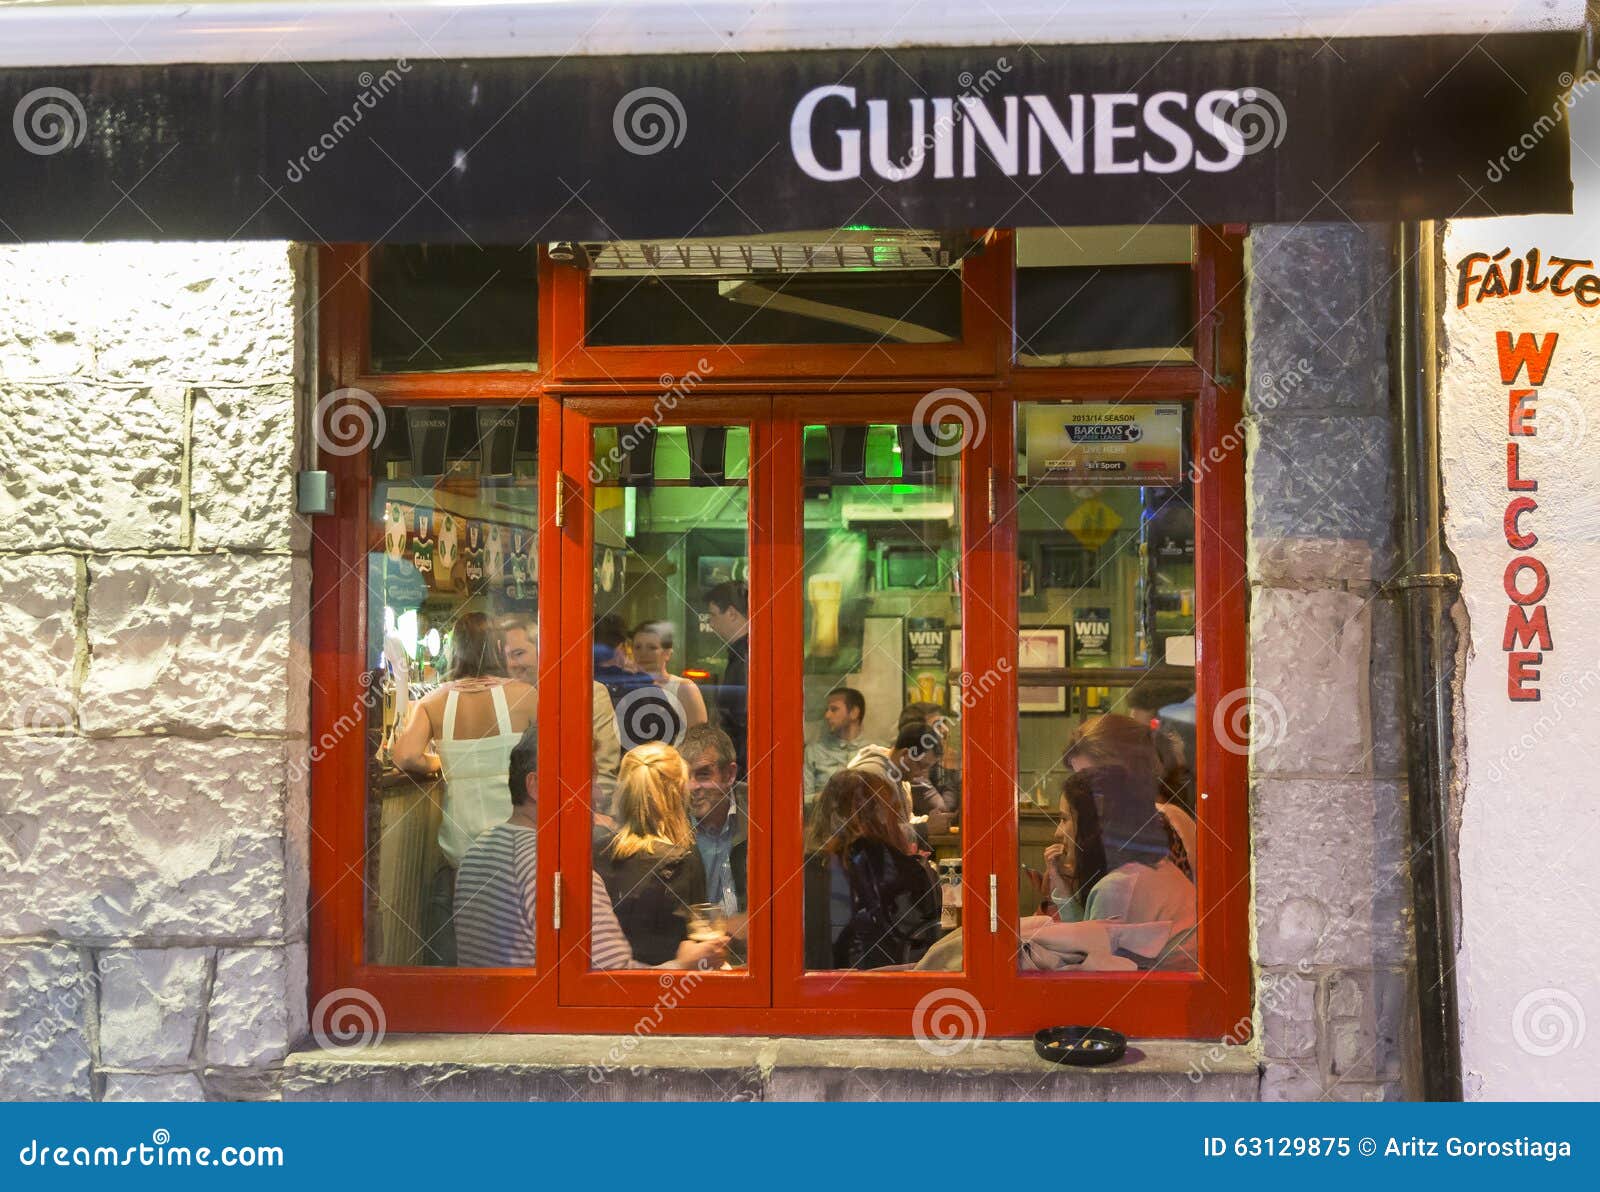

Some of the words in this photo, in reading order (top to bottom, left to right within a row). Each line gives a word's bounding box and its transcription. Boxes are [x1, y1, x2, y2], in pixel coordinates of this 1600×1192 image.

[790, 85, 1246, 182] GUINNESS
[1105, 414, 1135, 422] SEASON
[1074, 425, 1123, 435] BARCLAYS
[1100, 461, 1121, 470] Sport
[1496, 331, 1559, 702] WELCOME
[1074, 622, 1109, 635] WIN
[909, 631, 943, 645] WIN
